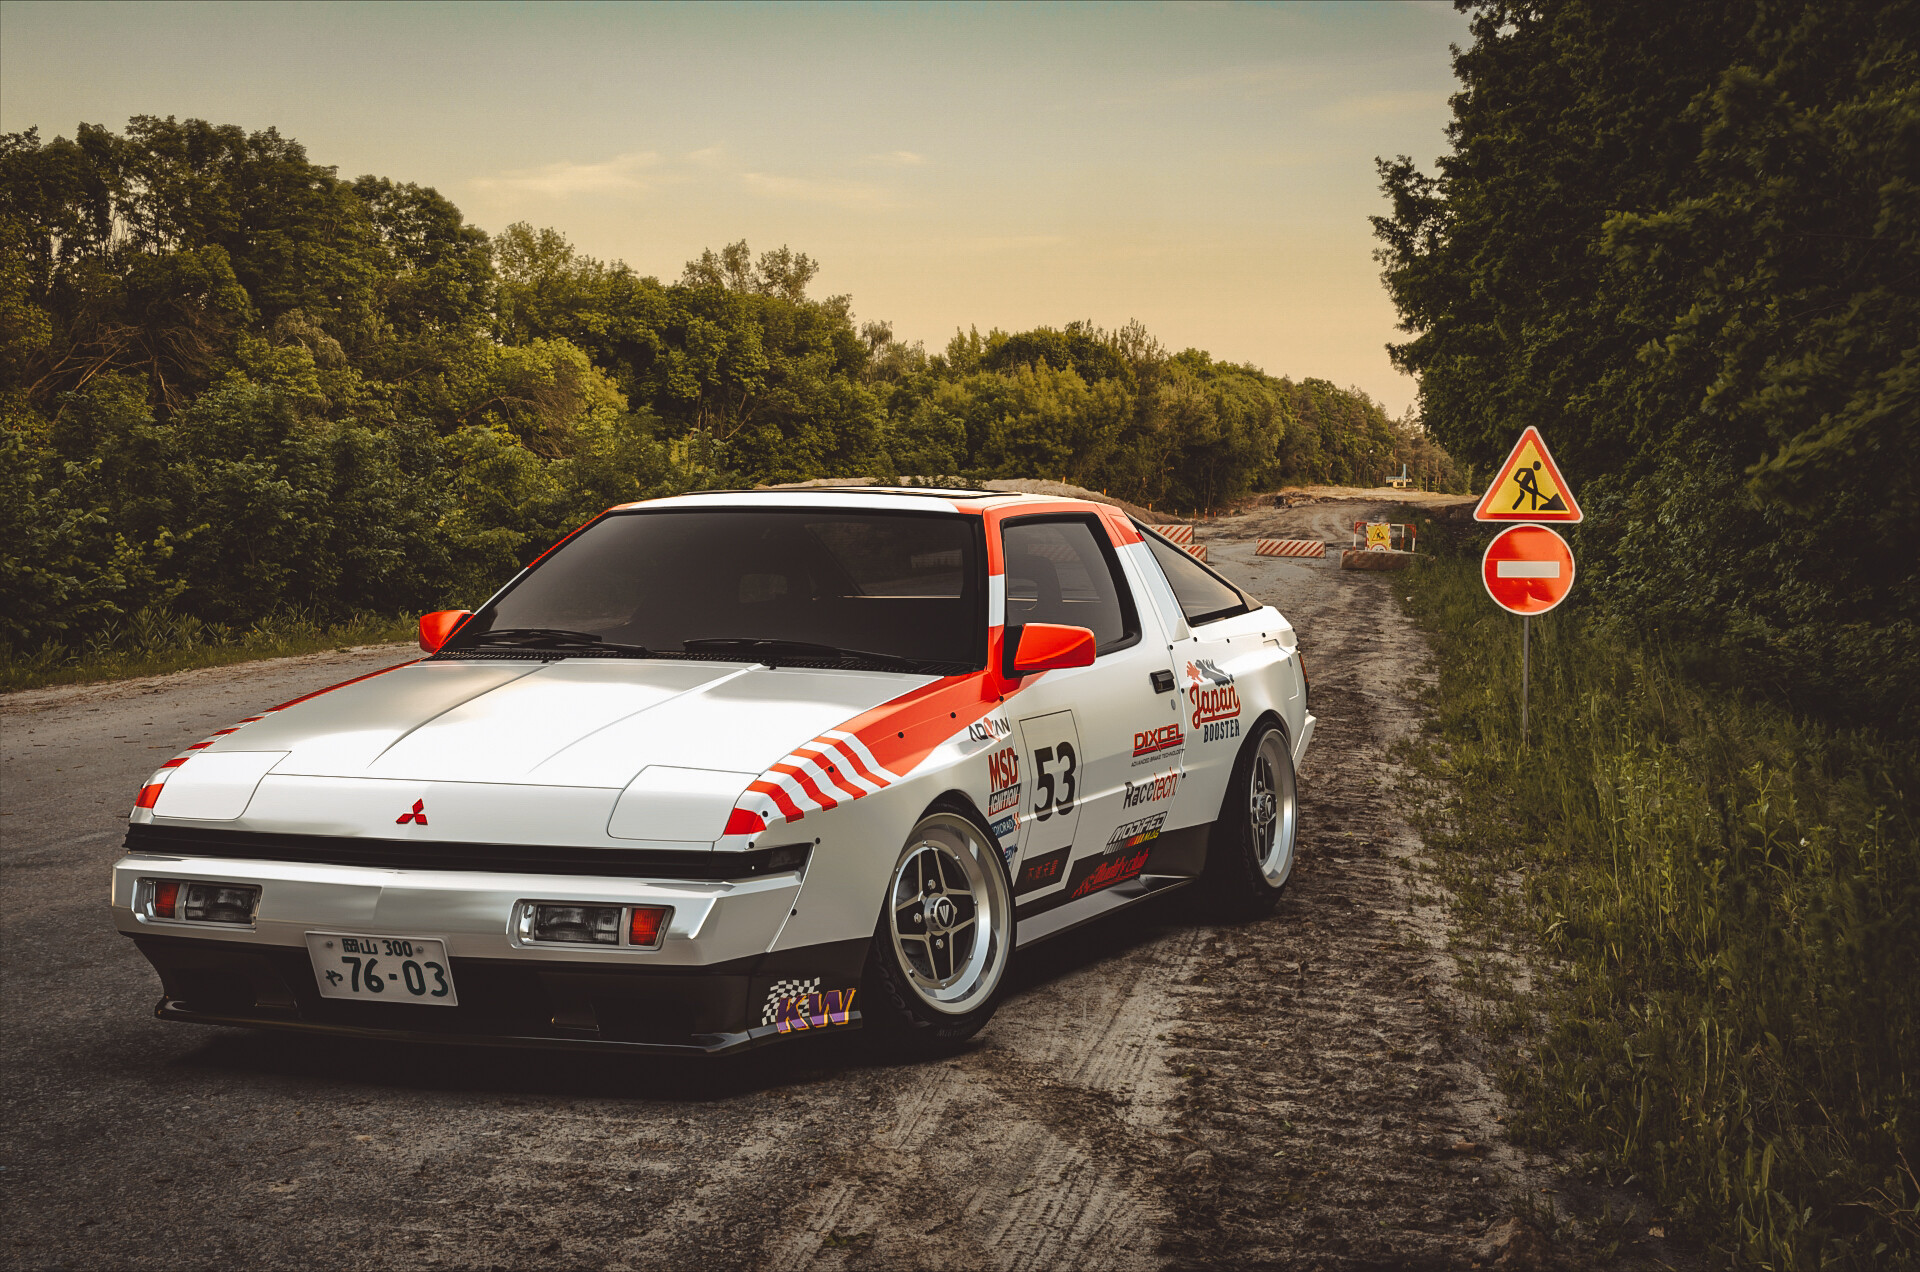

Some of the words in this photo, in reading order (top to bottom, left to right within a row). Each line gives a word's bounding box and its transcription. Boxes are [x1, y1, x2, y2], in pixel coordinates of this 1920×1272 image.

[1190, 683, 1240, 729] Japan
[968, 717, 1011, 742] ADVAN
[1134, 723, 1184, 751] DIXCEL
[1203, 719, 1240, 743] BOOSTER
[988, 747, 1019, 793] MSD
[1033, 741, 1077, 822] 53
[1123, 767, 1177, 809] Racetech
[342, 938, 379, 955] 岡山
[382, 939, 413, 957] 300
[341, 956, 449, 998] 76-03
[776, 988, 857, 1034] KW
